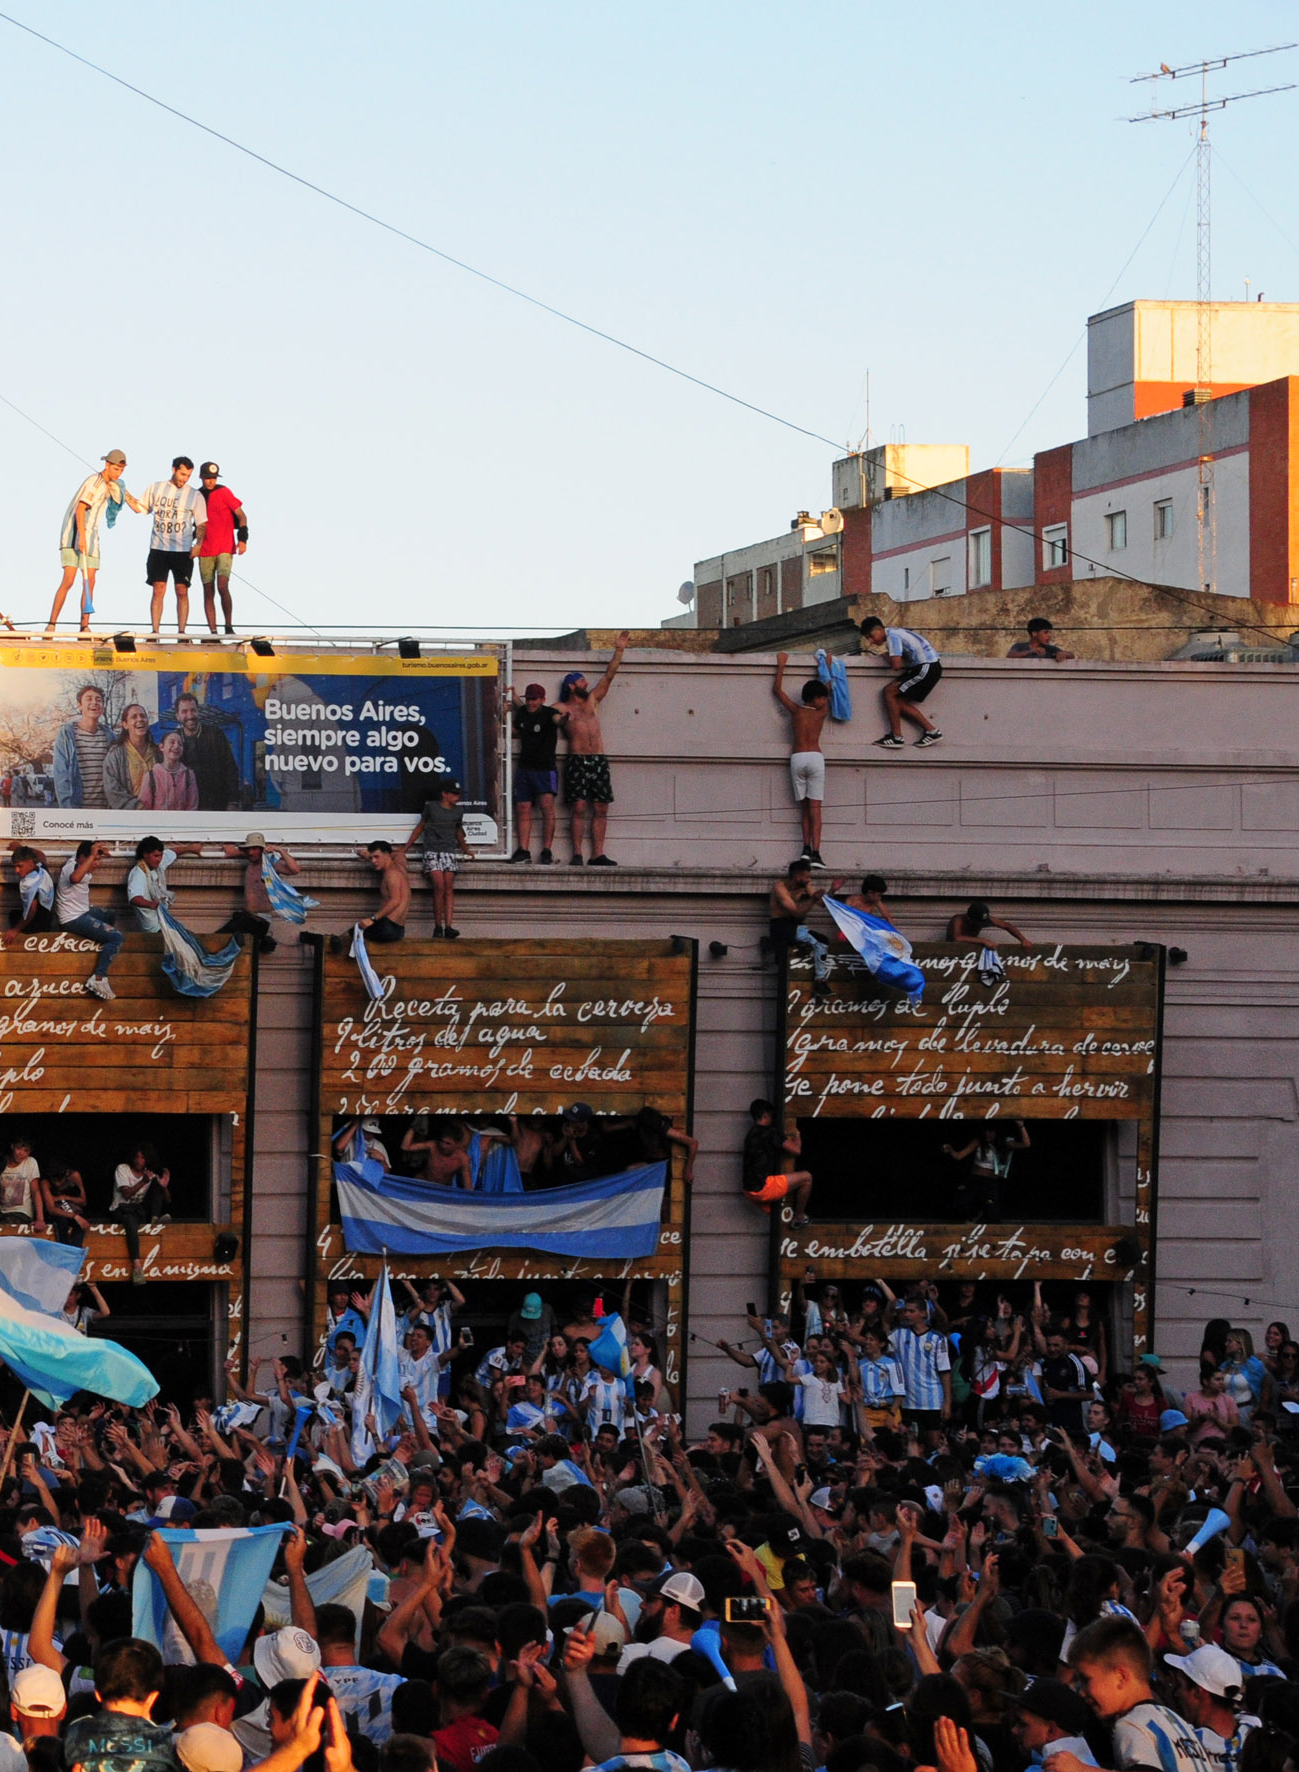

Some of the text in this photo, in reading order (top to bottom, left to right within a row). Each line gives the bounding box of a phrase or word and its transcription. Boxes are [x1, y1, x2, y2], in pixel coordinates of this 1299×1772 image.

[264, 699, 426, 726] Buenos Aires,
[263, 724, 419, 751] siempre algo
[264, 753, 452, 776] nuevo para vos.
[42, 820, 94, 829] Conocé más
[334, 1676, 361, 1685] YPF
